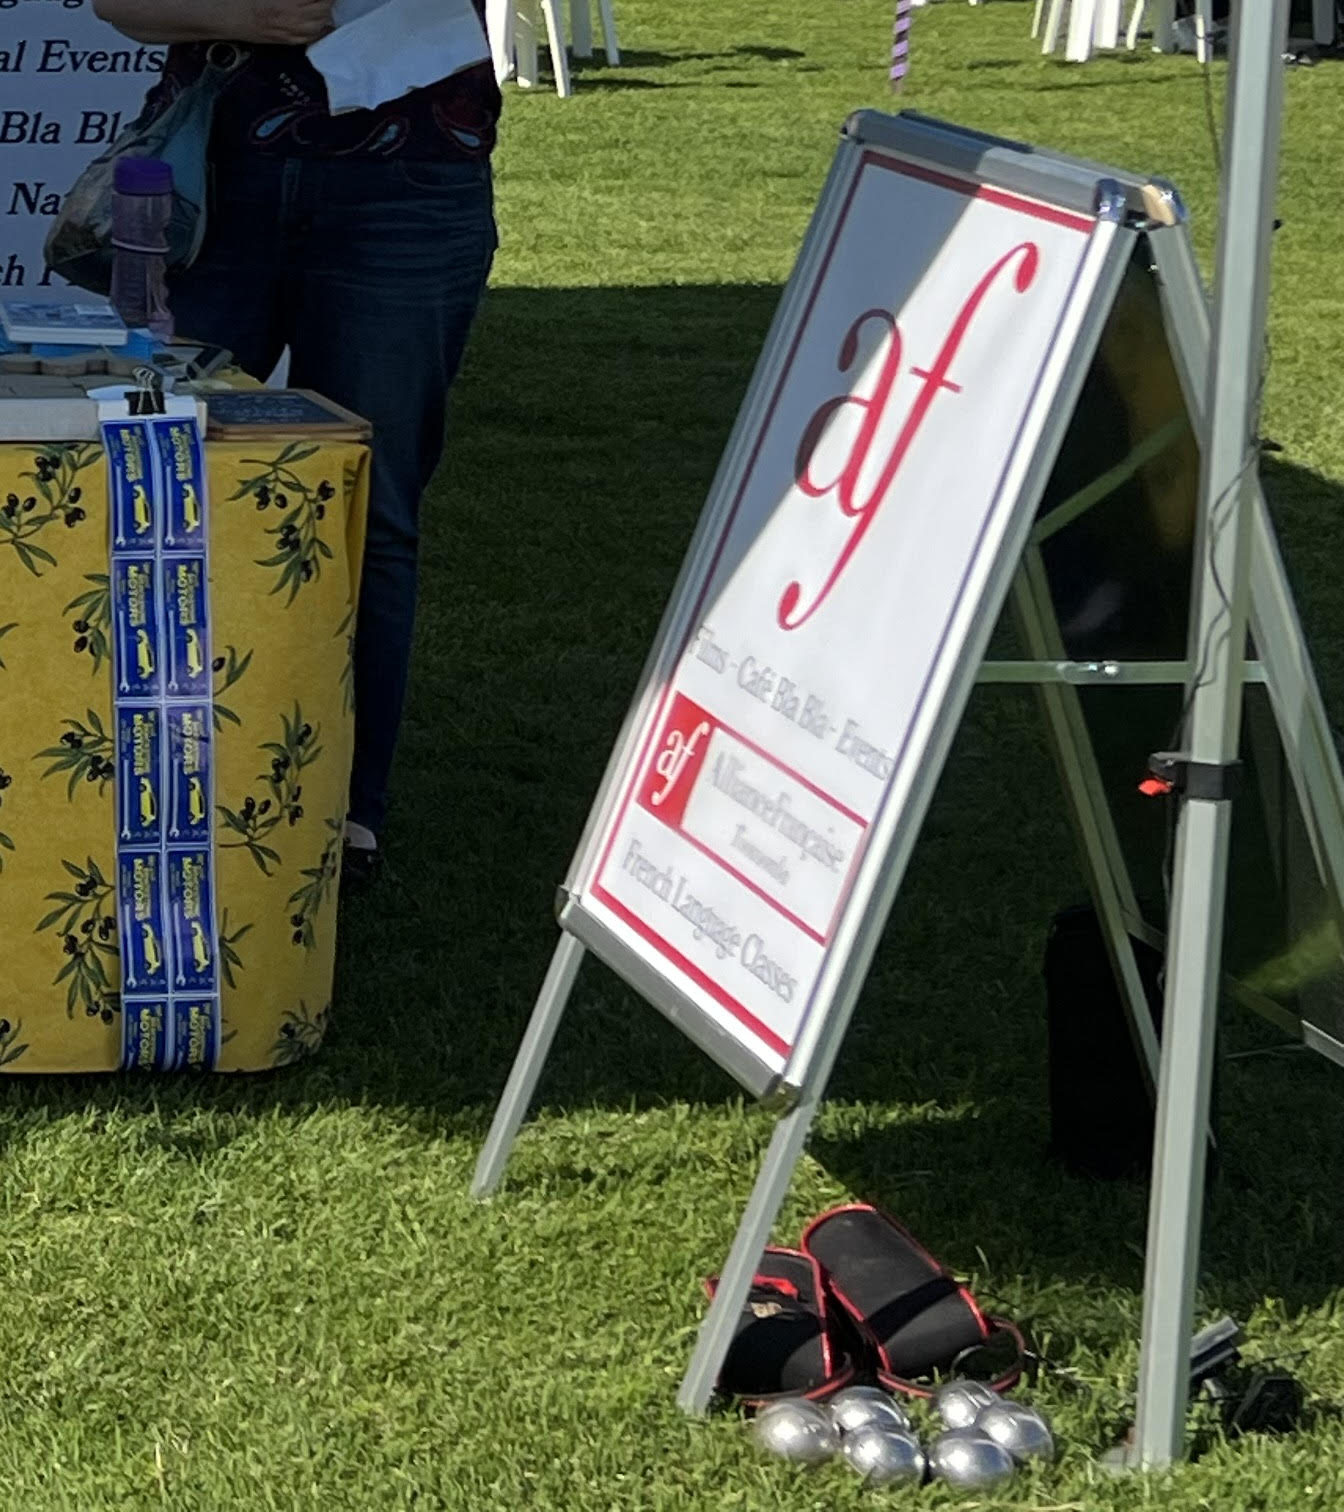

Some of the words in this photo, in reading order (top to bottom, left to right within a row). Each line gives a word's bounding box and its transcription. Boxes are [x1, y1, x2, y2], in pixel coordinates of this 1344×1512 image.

[36, 39, 165, 74] Events
[74, 110, 124, 146] Bl
[8, 182, 65, 216] Na
[777, 240, 1040, 632] af
[650, 720, 710, 807] af
